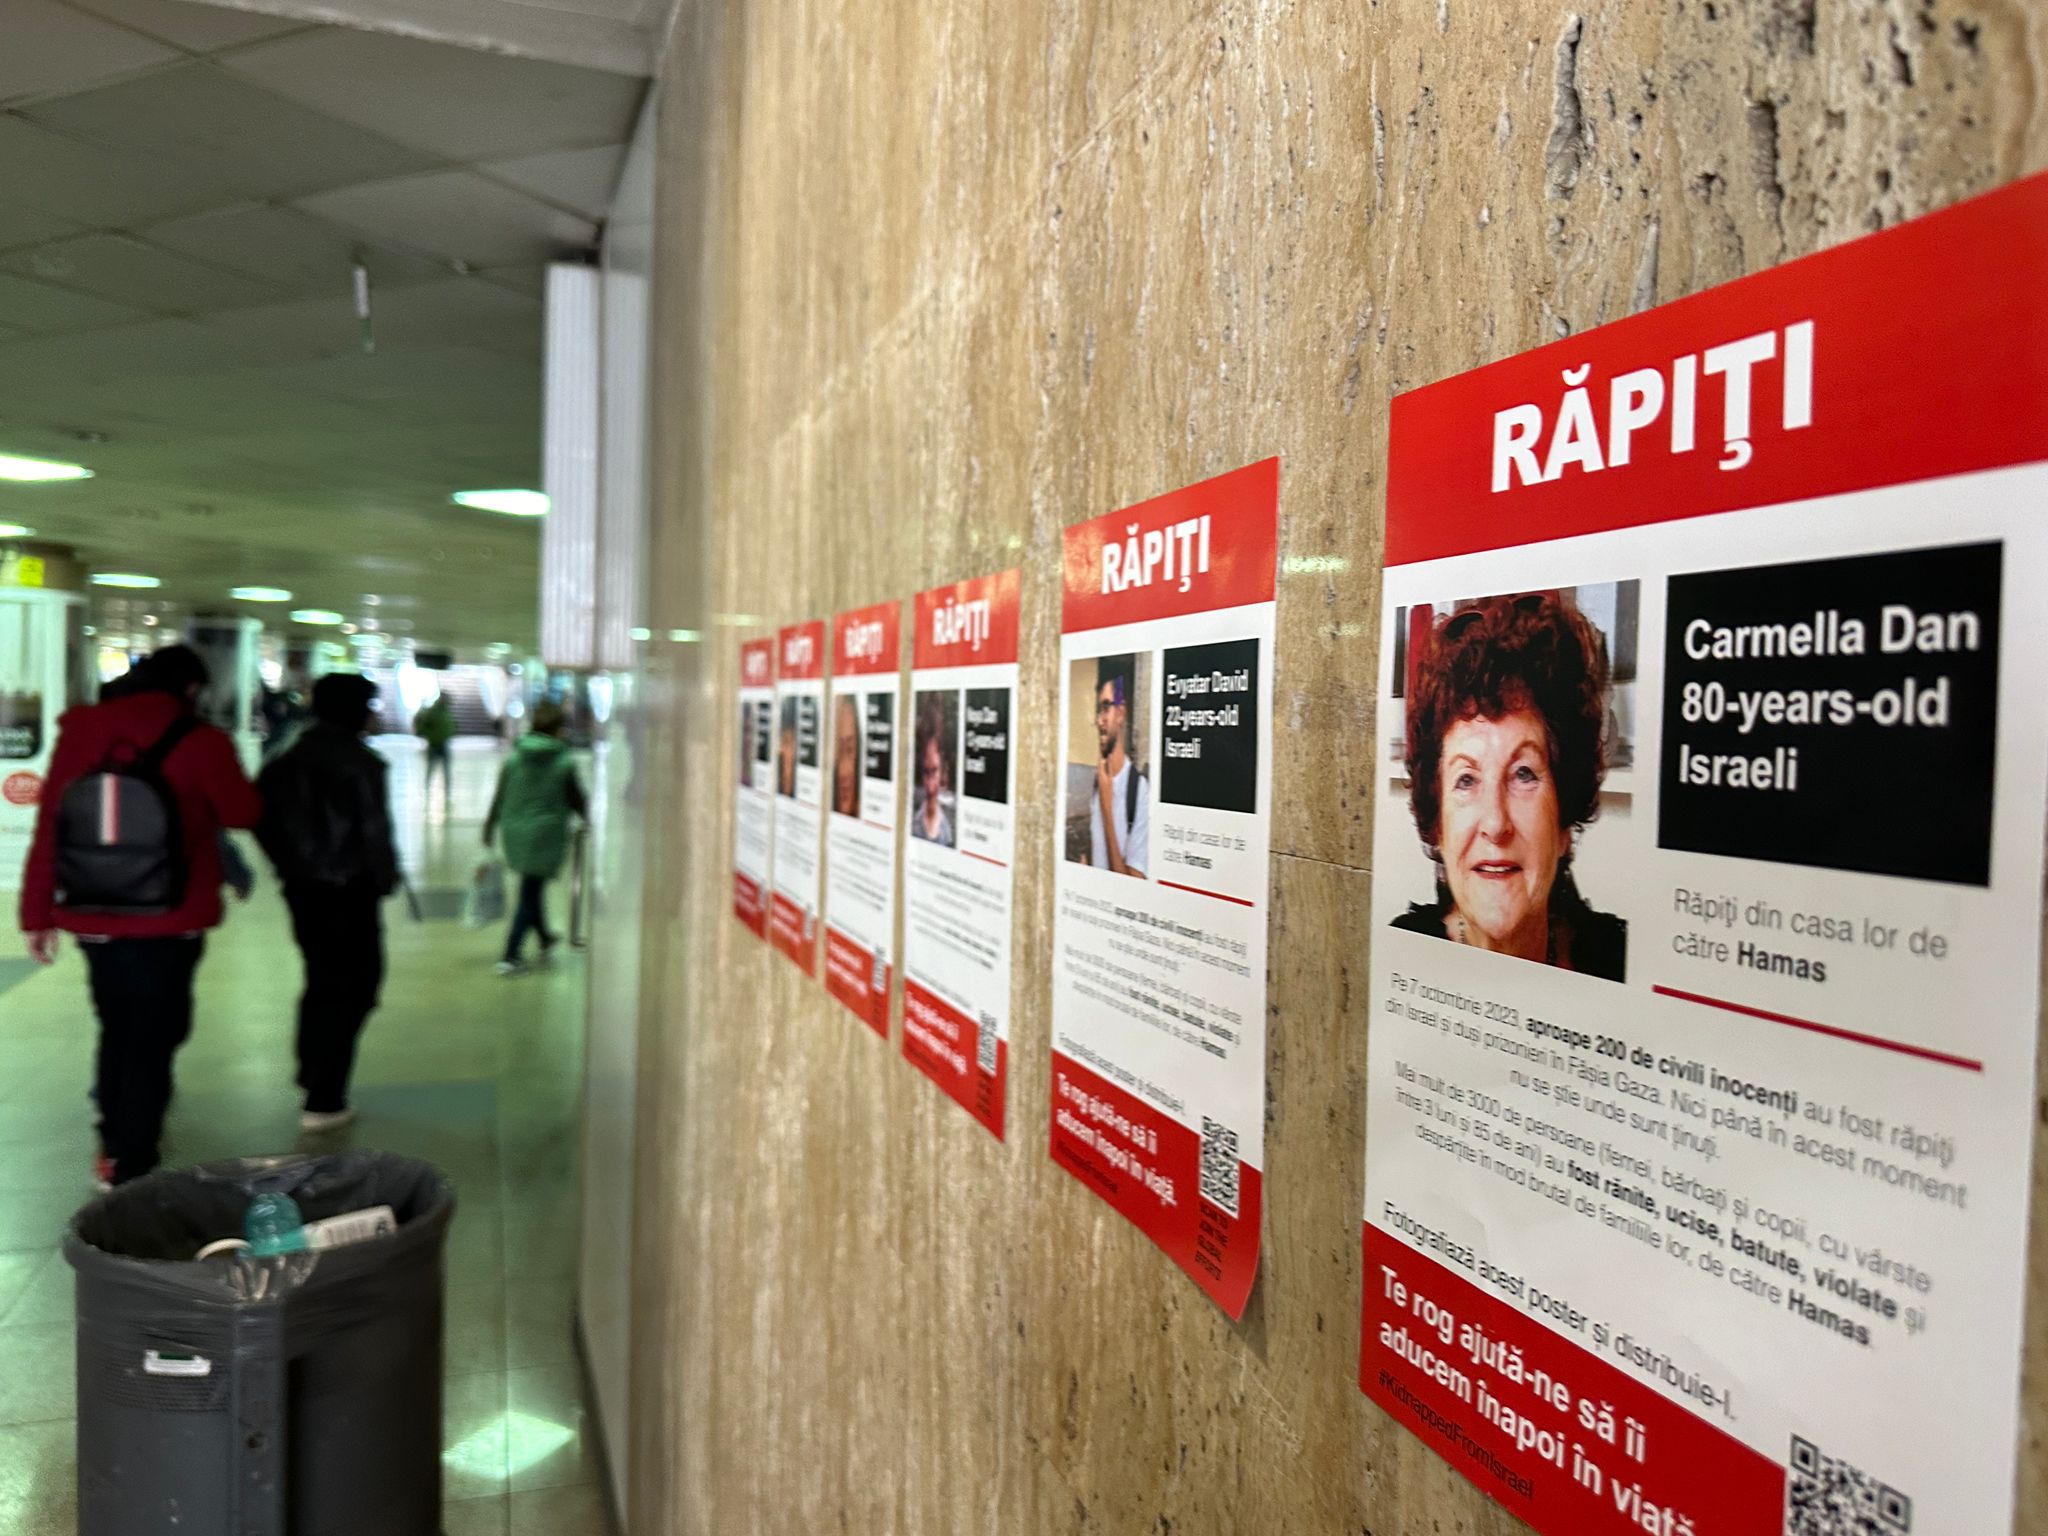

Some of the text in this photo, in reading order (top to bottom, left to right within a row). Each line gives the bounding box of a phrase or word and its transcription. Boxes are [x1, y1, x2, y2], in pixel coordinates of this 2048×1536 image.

[1683, 604, 1980, 661] Carmella Dan
[1211, 669, 1249, 693] David
[1681, 677, 1950, 734] 80-years-old
[1165, 704, 1240, 732] 22-years-old
[1165, 736, 1202, 759] Israeli
[1678, 744, 1799, 791] Israeli
[1672, 931, 1827, 983] către Hamas
[1745, 901, 1783, 930] din
[1790, 912, 1853, 943] casa
[1863, 917, 1898, 948] lor
[1908, 926, 1948, 959] de
[1056, 1071, 1071, 1099] Te
[1391, 972, 1407, 992] Pe
[1525, 1017, 1592, 1051] aproape
[1595, 1034, 1627, 1061] 200
[1630, 1046, 1654, 1070] de
[1658, 1055, 1705, 1085] civili
[1803, 1100, 1833, 1125] au
[1839, 1105, 1884, 1142] fost
[1384, 996, 1404, 1016] din
[1406, 1001, 1438, 1028] Israel
[1670, 1088, 1707, 1120] Nici
[1711, 1107, 1762, 1139] până
[1768, 1120, 1788, 1148] în
[1793, 1133, 1857, 1171] acest
[1862, 1155, 1968, 1209] moment
[1509, 1069, 1530, 1088] nu
[1532, 1076, 1551, 1096] se
[1584, 1095, 1626, 1124] unde
[1629, 1110, 1669, 1141] sunt
[1447, 1083, 1465, 1102] de
[1503, 1105, 1522, 1126] de
[1524, 1115, 1596, 1157] persoane
[1754, 1207, 1812, 1248] copii,
[1818, 1233, 1848, 1260] cu
[1854, 1247, 1932, 1293] vârste
[1492, 1129, 1513, 1151] de
[1544, 1153, 1564, 1174] au
[1567, 1158, 1600, 1190] fost
[1665, 1204, 1725, 1248] ucise,
[1813, 1266, 1898, 1319] violate
[1494, 1159, 1526, 1186] mod
[1527, 1172, 1572, 1208] brutal
[1574, 1194, 1597, 1218] de
[1698, 1250, 1725, 1278] de
[1729, 1265, 1782, 1304] către
[1383, 1200, 1475, 1272] Fotografiază
[1478, 1258, 1525, 1300] acest
[1527, 1285, 1589, 1334] poster
[1613, 1332, 1738, 1422] distribuie-l.
[1380, 1264, 1647, 1464] Te rog ajută-ne să îi
[1378, 1368, 1535, 1500] #KidnappedFromIsrael
[1379, 1320, 1473, 1404] aducem
[1476, 1379, 1566, 1470] înapoi
[1572, 1441, 1603, 1496] în
